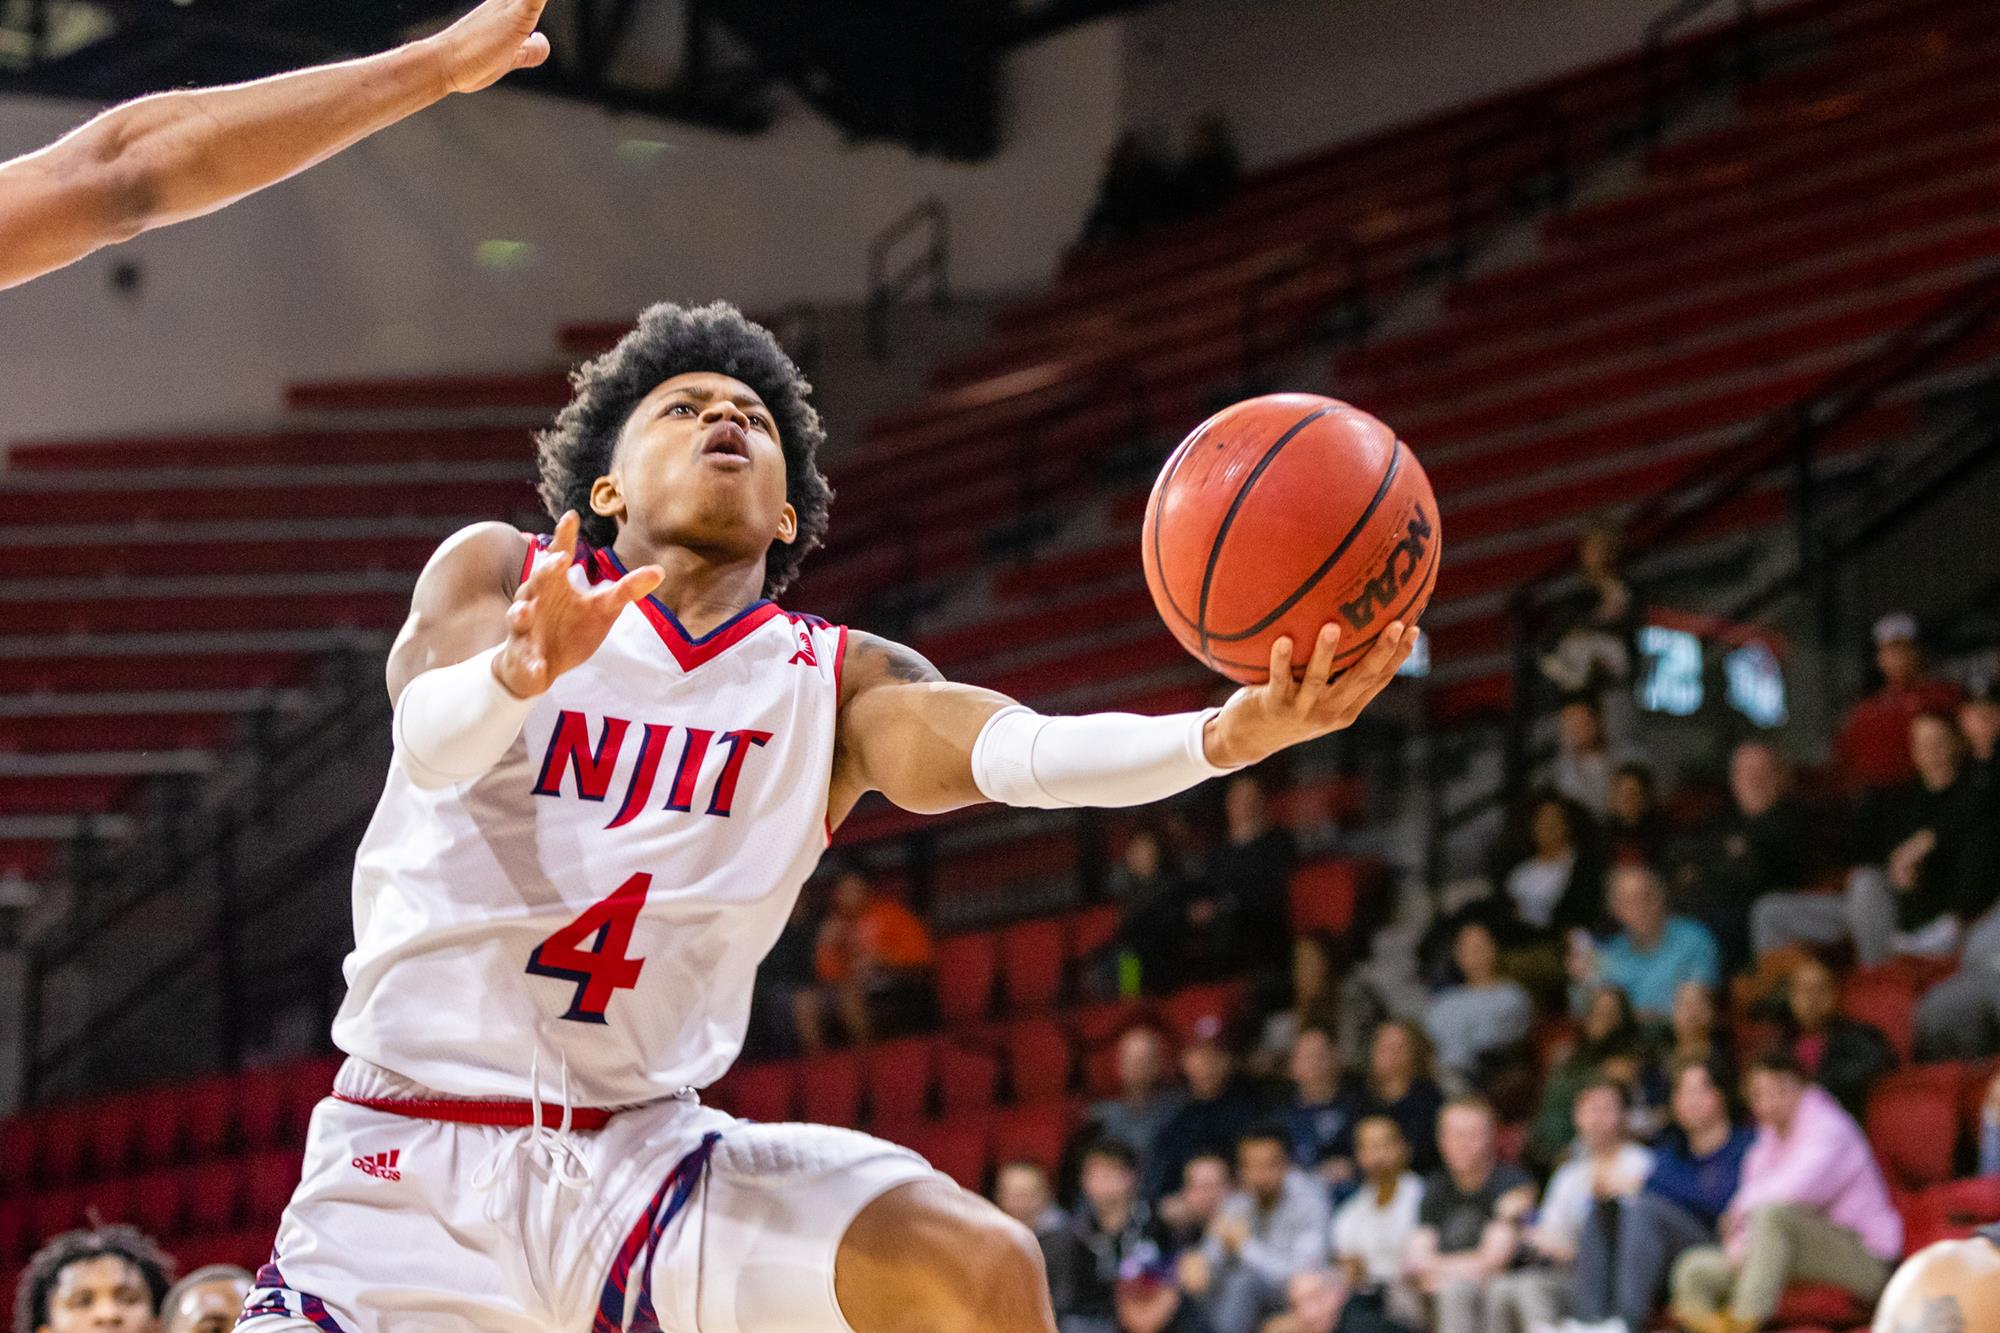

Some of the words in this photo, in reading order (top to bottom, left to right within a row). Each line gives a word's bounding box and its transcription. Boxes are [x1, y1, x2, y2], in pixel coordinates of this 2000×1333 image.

[1339, 503, 1431, 631] NCAA
[530, 709, 774, 830] NJIT
[525, 872, 653, 1025] 4
[352, 1157, 401, 1182] addas
